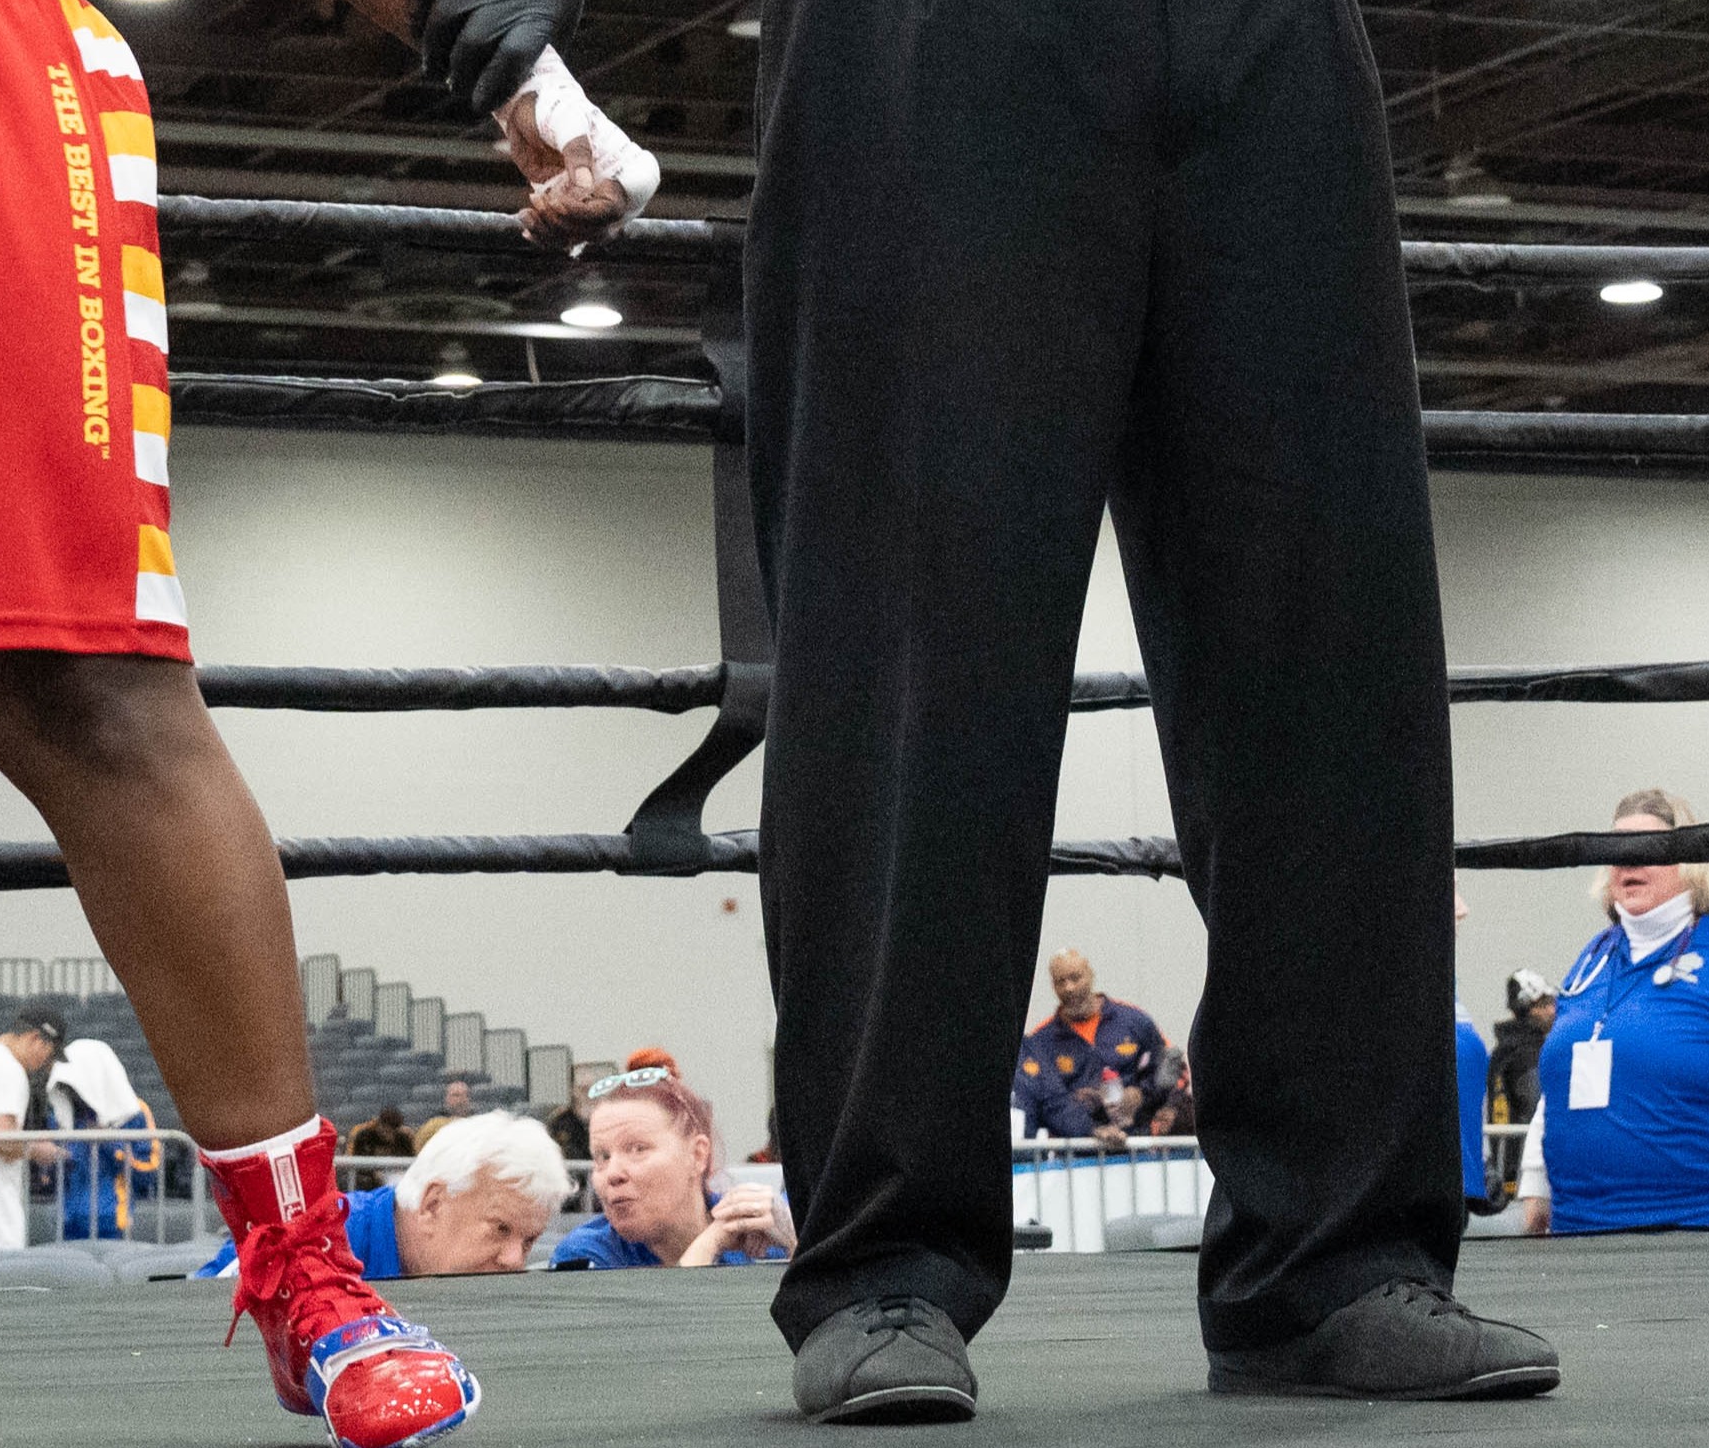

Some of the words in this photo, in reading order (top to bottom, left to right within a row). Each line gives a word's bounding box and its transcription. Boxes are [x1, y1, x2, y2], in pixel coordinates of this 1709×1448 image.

[46, 62, 86, 136] THE
[63, 142, 99, 237] BEST
[74, 243, 102, 290] IN
[78, 295, 110, 447] BOXING
